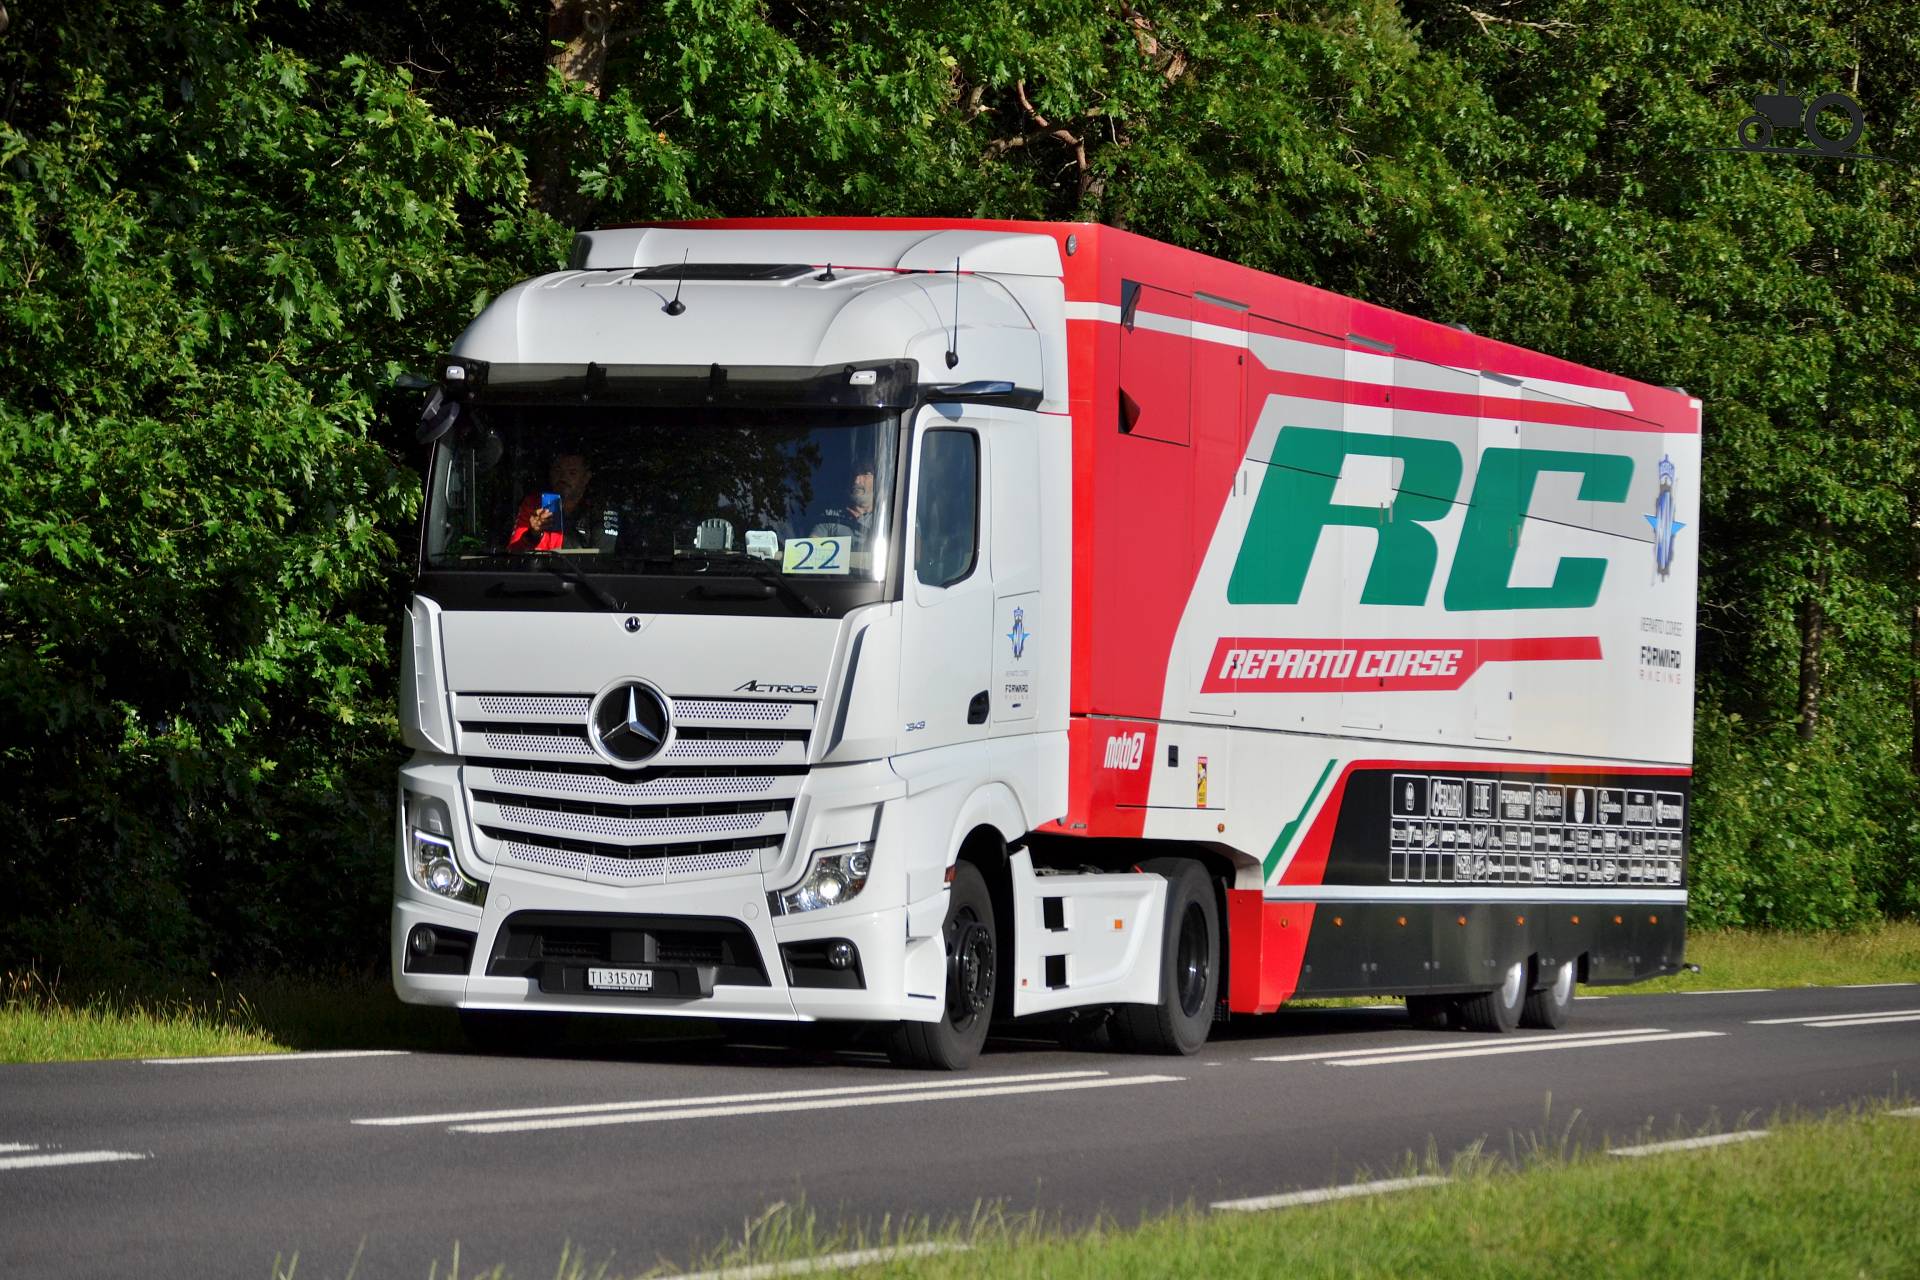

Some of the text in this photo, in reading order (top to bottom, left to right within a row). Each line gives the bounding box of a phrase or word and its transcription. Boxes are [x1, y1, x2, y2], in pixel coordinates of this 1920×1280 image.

[1227, 426, 1635, 611] RC
[792, 540, 840, 570] 22
[1219, 649, 1463, 679] REPARTO CORSE
[1641, 645, 1681, 669] FORWARD
[1005, 684, 1029, 693] FORWARD
